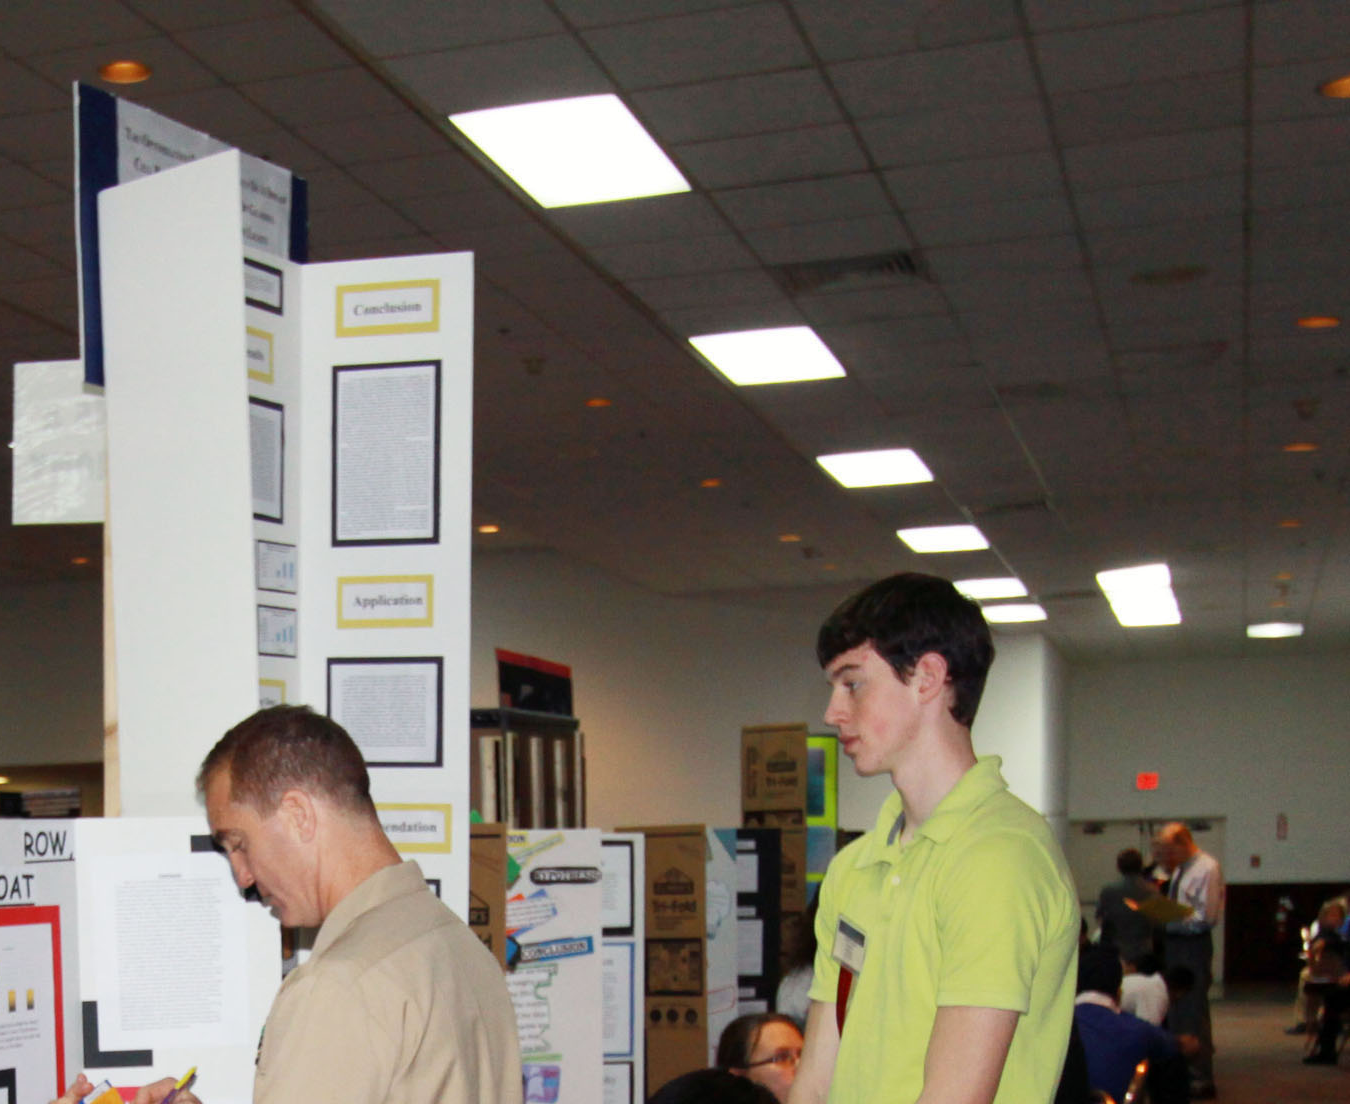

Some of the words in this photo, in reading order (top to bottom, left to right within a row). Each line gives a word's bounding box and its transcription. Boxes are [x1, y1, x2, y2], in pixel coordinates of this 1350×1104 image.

[352, 299, 422, 317] Conclusion
[353, 593, 423, 609] Application
[382, 821, 437, 834] endation
